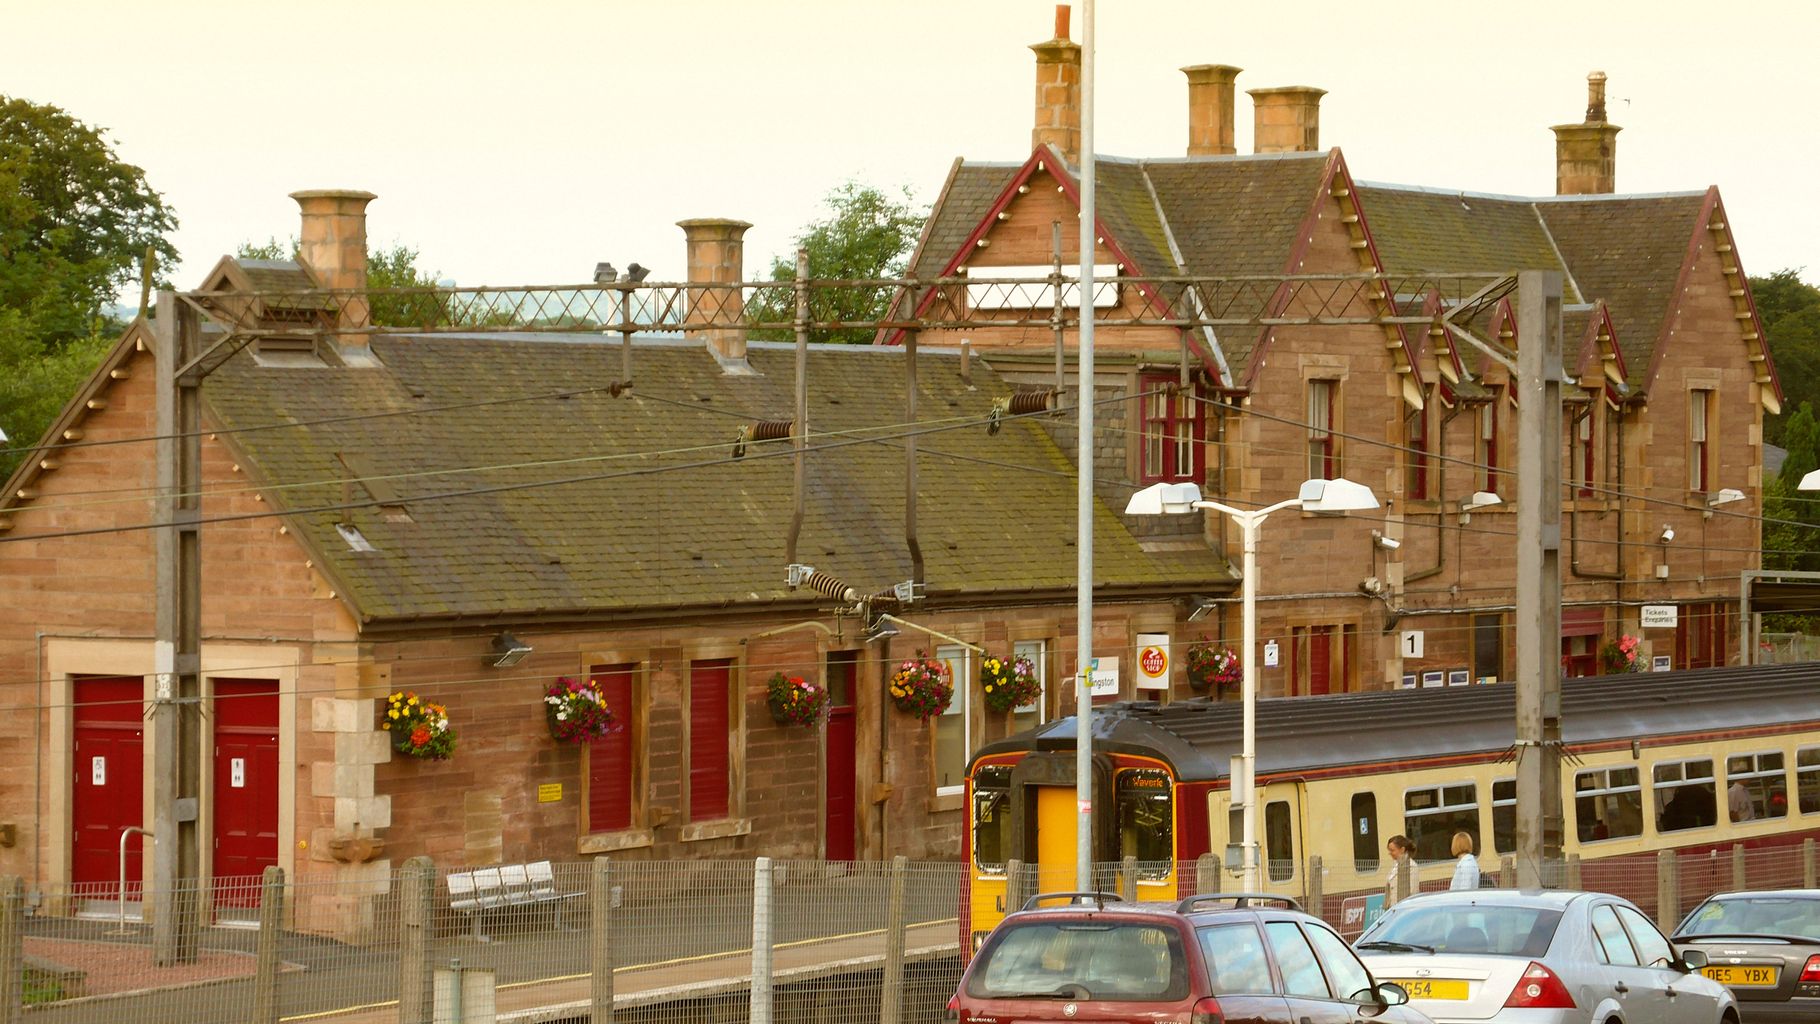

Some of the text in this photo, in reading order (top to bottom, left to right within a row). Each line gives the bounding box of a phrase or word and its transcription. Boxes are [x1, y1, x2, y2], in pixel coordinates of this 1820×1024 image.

[1407, 635, 1415, 654] 1
[1143, 659, 1163, 667] COFFEE
[1744, 969, 1769, 982] YBX
